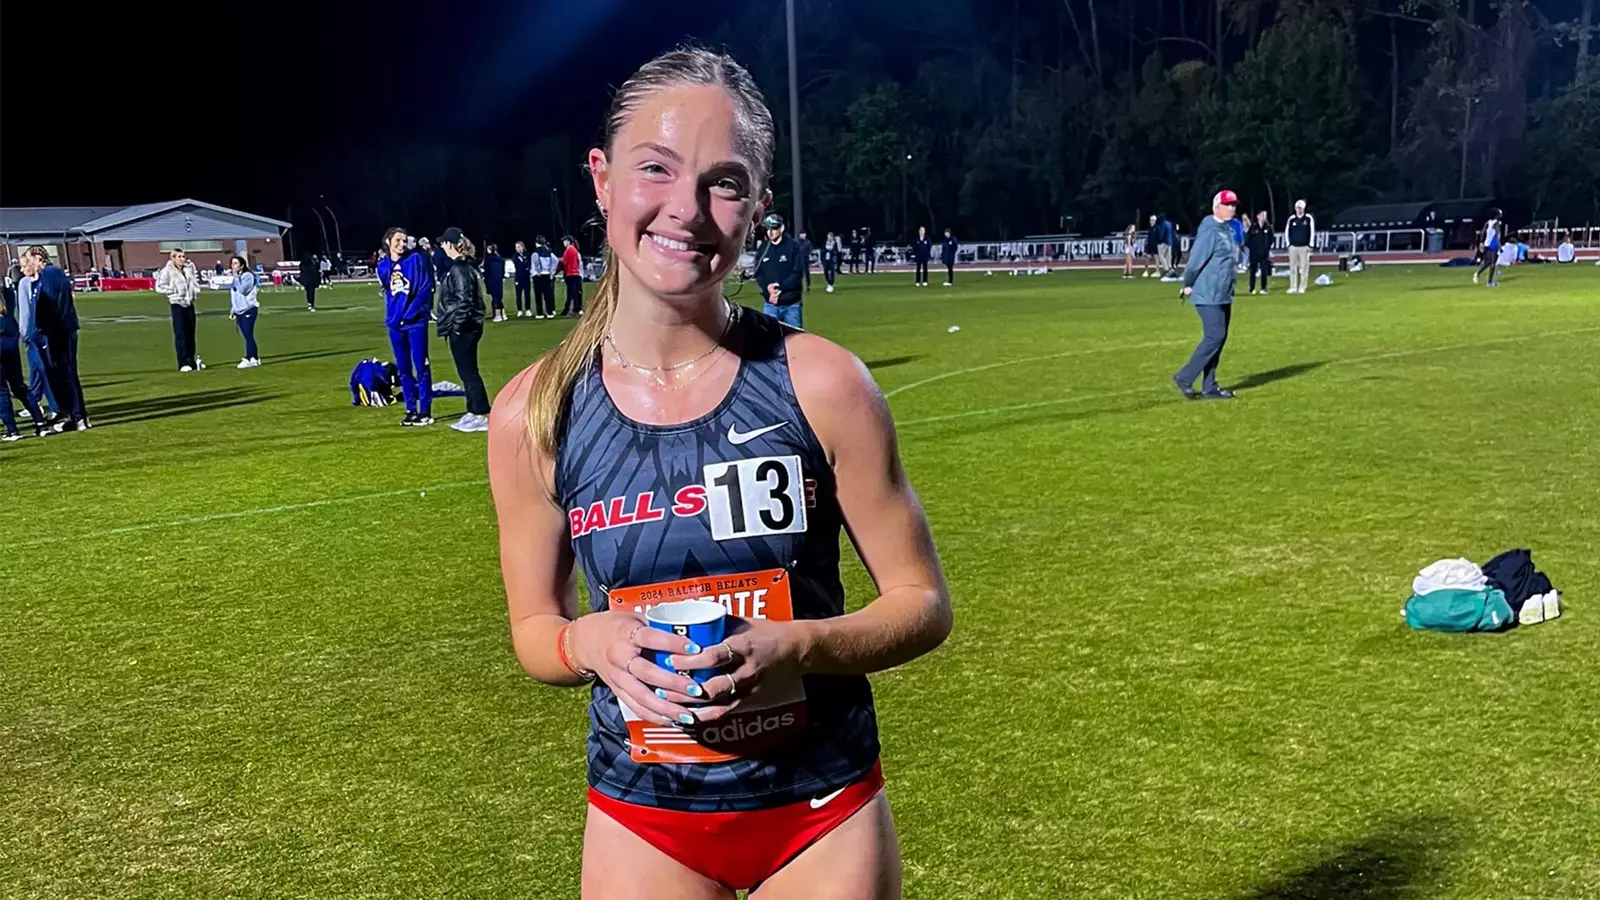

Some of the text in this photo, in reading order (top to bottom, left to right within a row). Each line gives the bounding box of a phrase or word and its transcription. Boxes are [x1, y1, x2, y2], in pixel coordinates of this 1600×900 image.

[568, 491, 664, 539] BALL
[714, 460, 795, 534] 13
[641, 578, 758, 600] 2024 RALEIGH RELAYS
[702, 711, 795, 744] adidas
